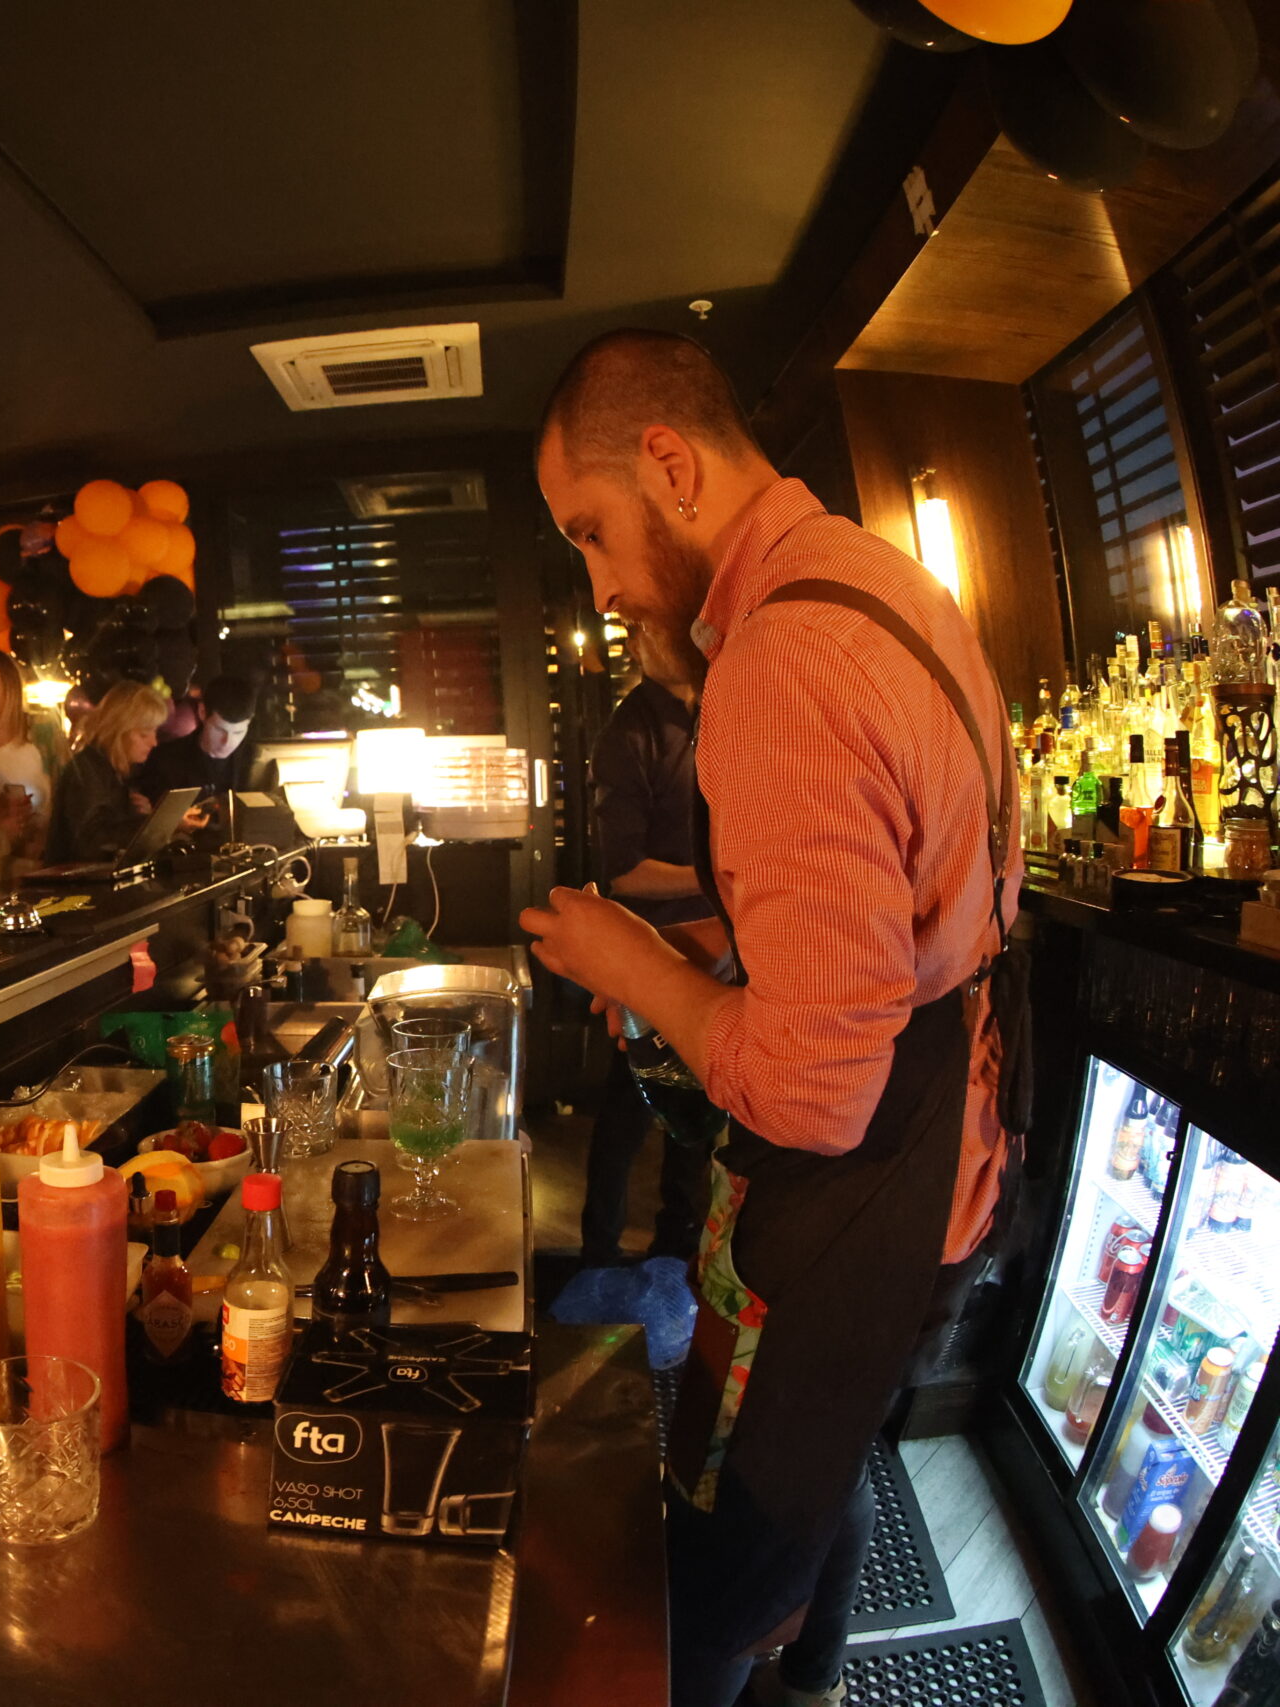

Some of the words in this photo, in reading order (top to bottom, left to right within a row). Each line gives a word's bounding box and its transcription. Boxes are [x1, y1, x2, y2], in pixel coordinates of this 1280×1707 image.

[396, 1367, 420, 1380] fta
[293, 1421, 345, 1455] fta
[275, 1481, 320, 1496] VASO
[322, 1485, 364, 1500] SHOT
[269, 1509, 367, 1531] CAMPECHE
